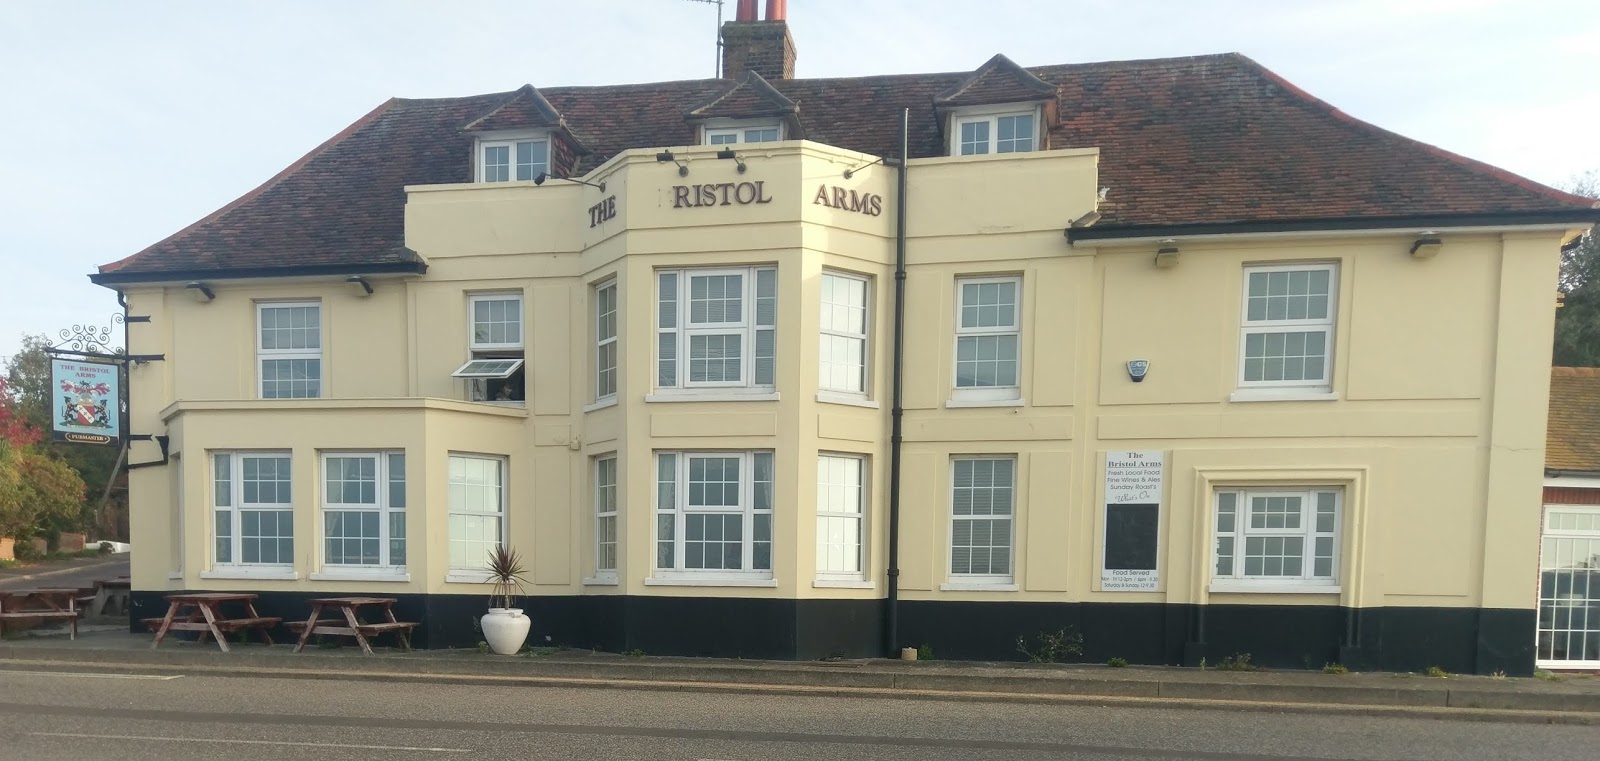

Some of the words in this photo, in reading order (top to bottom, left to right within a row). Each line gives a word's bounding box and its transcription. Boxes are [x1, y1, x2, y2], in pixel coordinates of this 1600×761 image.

[588, 195, 616, 228] THE
[673, 181, 772, 209] RISTOL
[813, 184, 882, 217] ARMS
